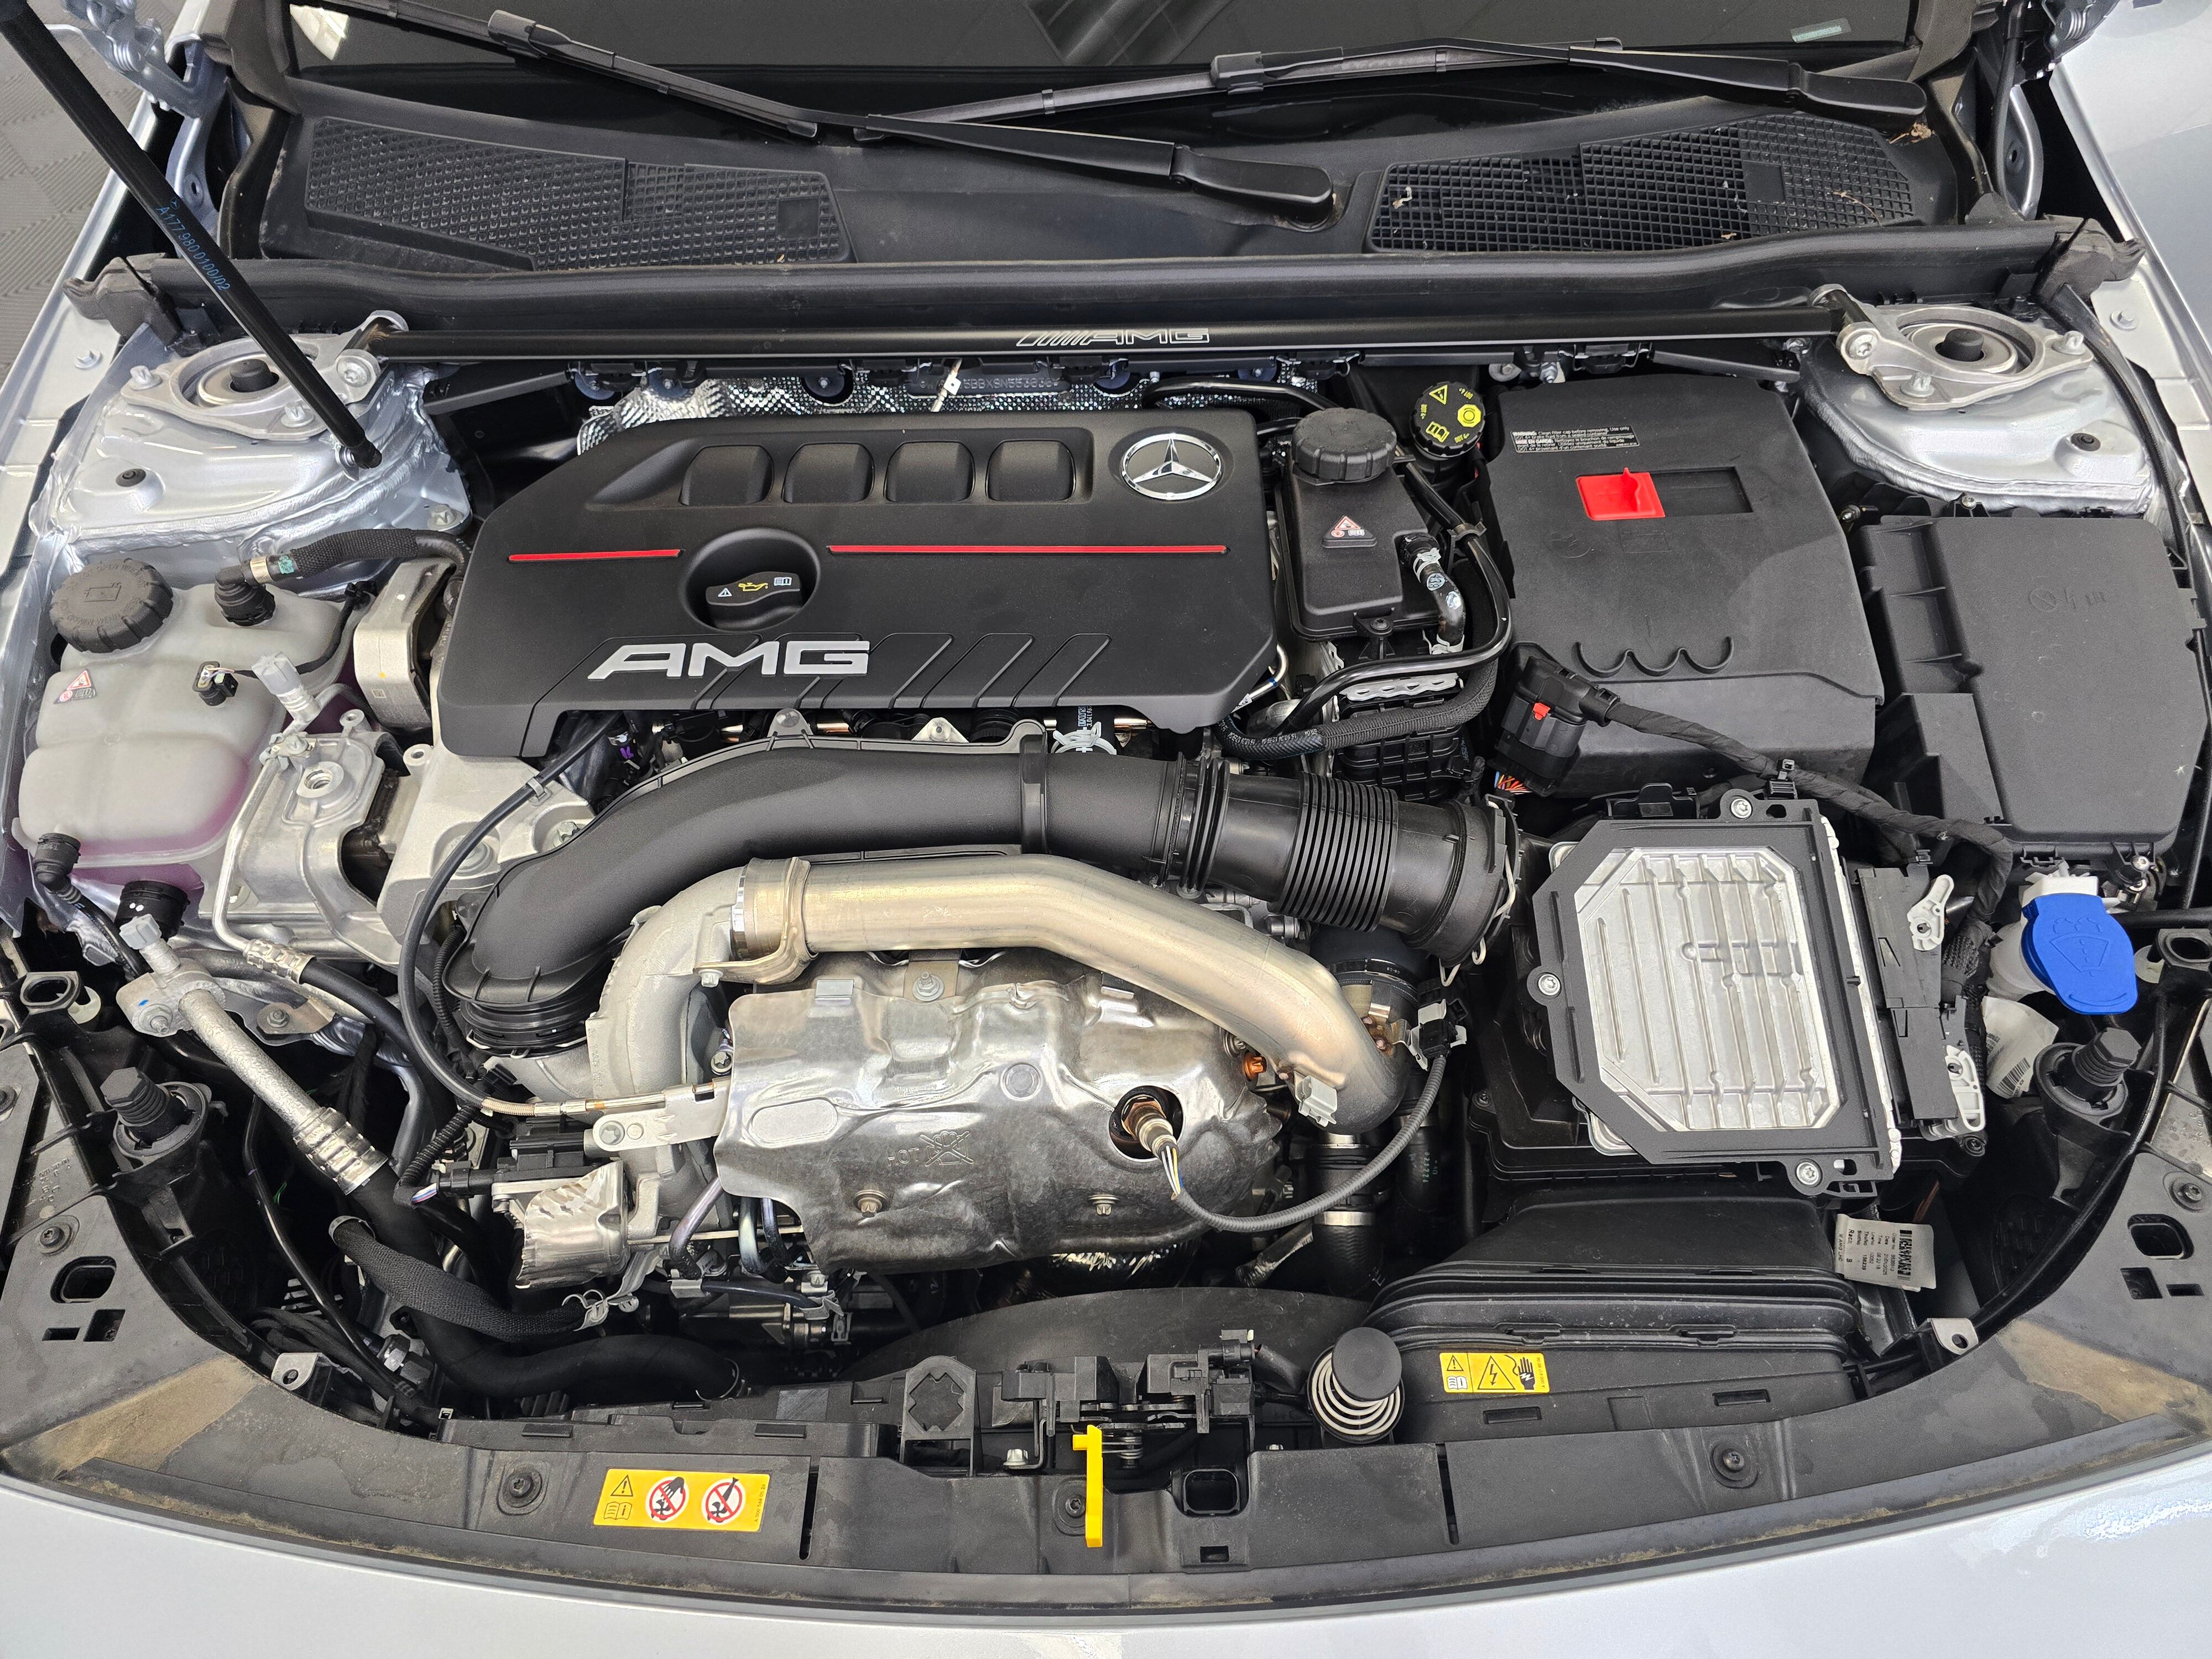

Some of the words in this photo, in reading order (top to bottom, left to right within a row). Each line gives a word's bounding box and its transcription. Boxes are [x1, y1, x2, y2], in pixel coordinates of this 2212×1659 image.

[1079, 328, 1210, 346] AMG
[587, 640, 870, 680] AMG
[886, 1147, 920, 1168] HOT
